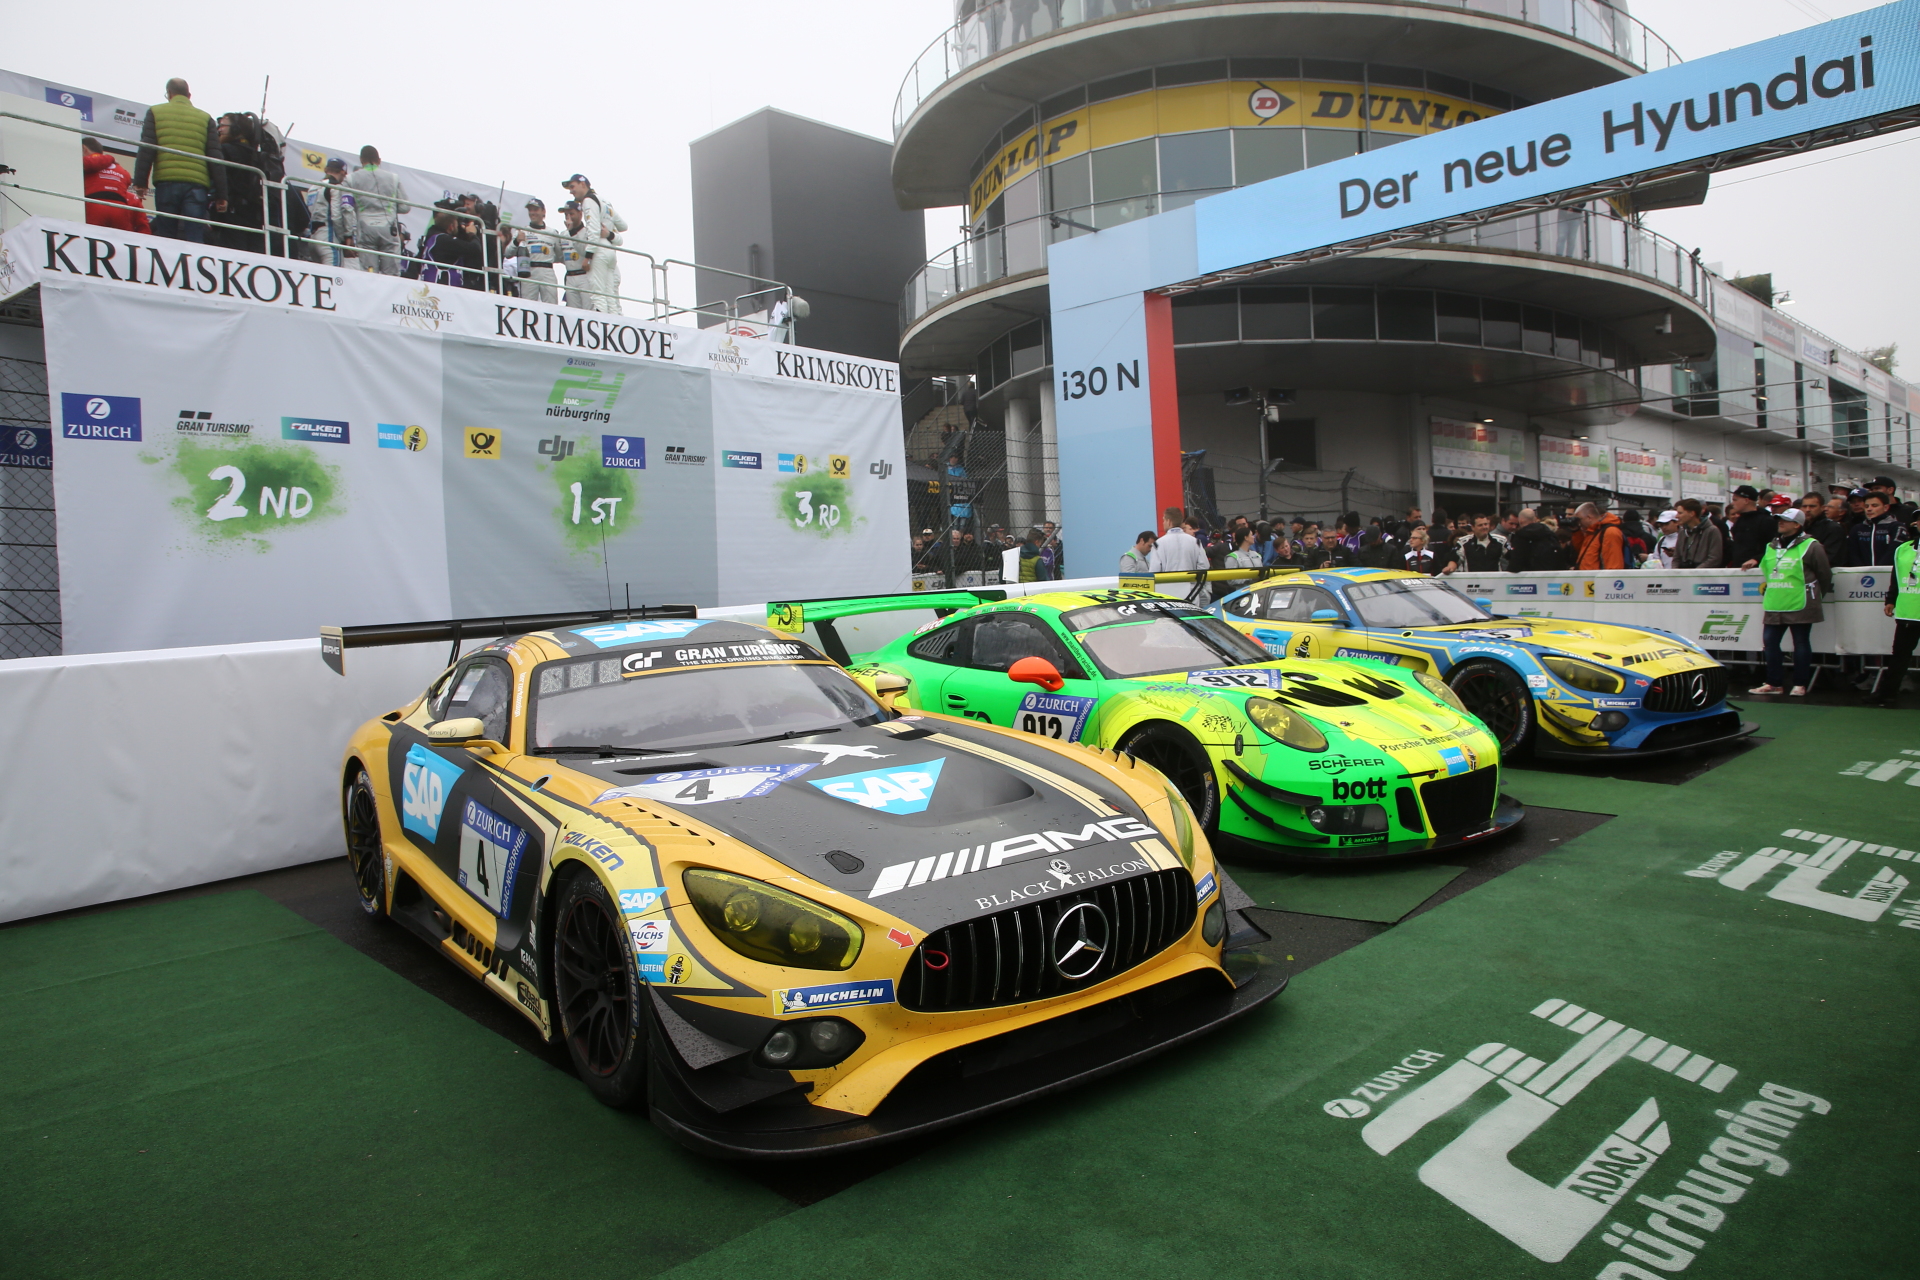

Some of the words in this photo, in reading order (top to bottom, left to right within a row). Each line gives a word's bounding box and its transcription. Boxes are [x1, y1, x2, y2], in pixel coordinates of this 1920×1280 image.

[1311, 90, 1497, 130] DUNLO
[1339, 169, 1419, 219] Der
[1444, 132, 1571, 193] neue
[1602, 35, 1876, 154] Hyundai
[973, 119, 1078, 215] DUNLOP
[41, 229, 337, 311] KRIMSKOYE
[391, 303, 454, 323] KRIMSKOYE
[495, 304, 675, 360] KRIMSKOYE
[573, 359, 596, 367] ZURICH
[708, 352, 749, 366] KRIMSKOYE
[775, 350, 896, 392] KRIMSKOYE
[1062, 366, 1108, 401] i30
[1117, 360, 1140, 391] N
[563, 397, 580, 406] ADAC
[546, 407, 611, 423] nürburgring
[67, 423, 132, 438] ZURICH
[176, 420, 204, 431] GRAN
[206, 422, 250, 433] TURISMO
[291, 422, 342, 433] FALKEN
[378, 432, 403, 441] BILSTEIN
[538, 435, 575, 461] dji
[665, 454, 680, 462] GRAN
[681, 455, 706, 463] TURISMO
[727, 454, 757, 462] FALKEN
[605, 457, 641, 467] ZURICH
[206, 465, 248, 521] 2
[259, 486, 313, 518] ND
[570, 481, 582, 525] 1
[591, 497, 622, 526] ST
[795, 491, 813, 527] 3
[819, 504, 840, 529] RD
[580, 621, 701, 641] SAP
[1699, 634, 1740, 643] nürburgring
[675, 647, 727, 660] GRAN
[728, 644, 799, 656] TURISMO
[1263, 642, 1286, 655] STEIN
[1459, 646, 1514, 658] FALKEN
[1203, 674, 1268, 687] 912
[1038, 697, 1080, 712] ZURICH
[1023, 713, 1062, 739] 912
[1071, 699, 1093, 742] NORDRHEIN
[1379, 738, 1423, 752] Porsche
[1421, 732, 1454, 746] Zentrum
[688, 765, 781, 778] ZURICH
[1308, 759, 1385, 770] SCHERER
[403, 761, 443, 830] SAP
[674, 778, 715, 801] 4
[752, 781, 775, 796] ADAC
[822, 771, 934, 809] SAP
[1332, 777, 1387, 800] bott
[476, 809, 512, 843] ZURICH
[561, 831, 625, 872] FALKEN
[986, 817, 1159, 868] AMG
[477, 838, 490, 898] 4
[505, 828, 527, 888] NORDRHEIN
[974, 881, 1058, 910] BLACK
[1075, 858, 1150, 886] FALCON
[1859, 882, 1899, 904] ADAC
[502, 886, 511, 917] ADAC
[618, 892, 656, 909] SAP
[631, 931, 664, 940] FUCHS
[808, 987, 884, 1004] MICHELIN
[1351, 1049, 1445, 1102] ZURICH
[1568, 1146, 1648, 1206] ADAC
[1595, 1081, 1832, 1280] nürburgring
